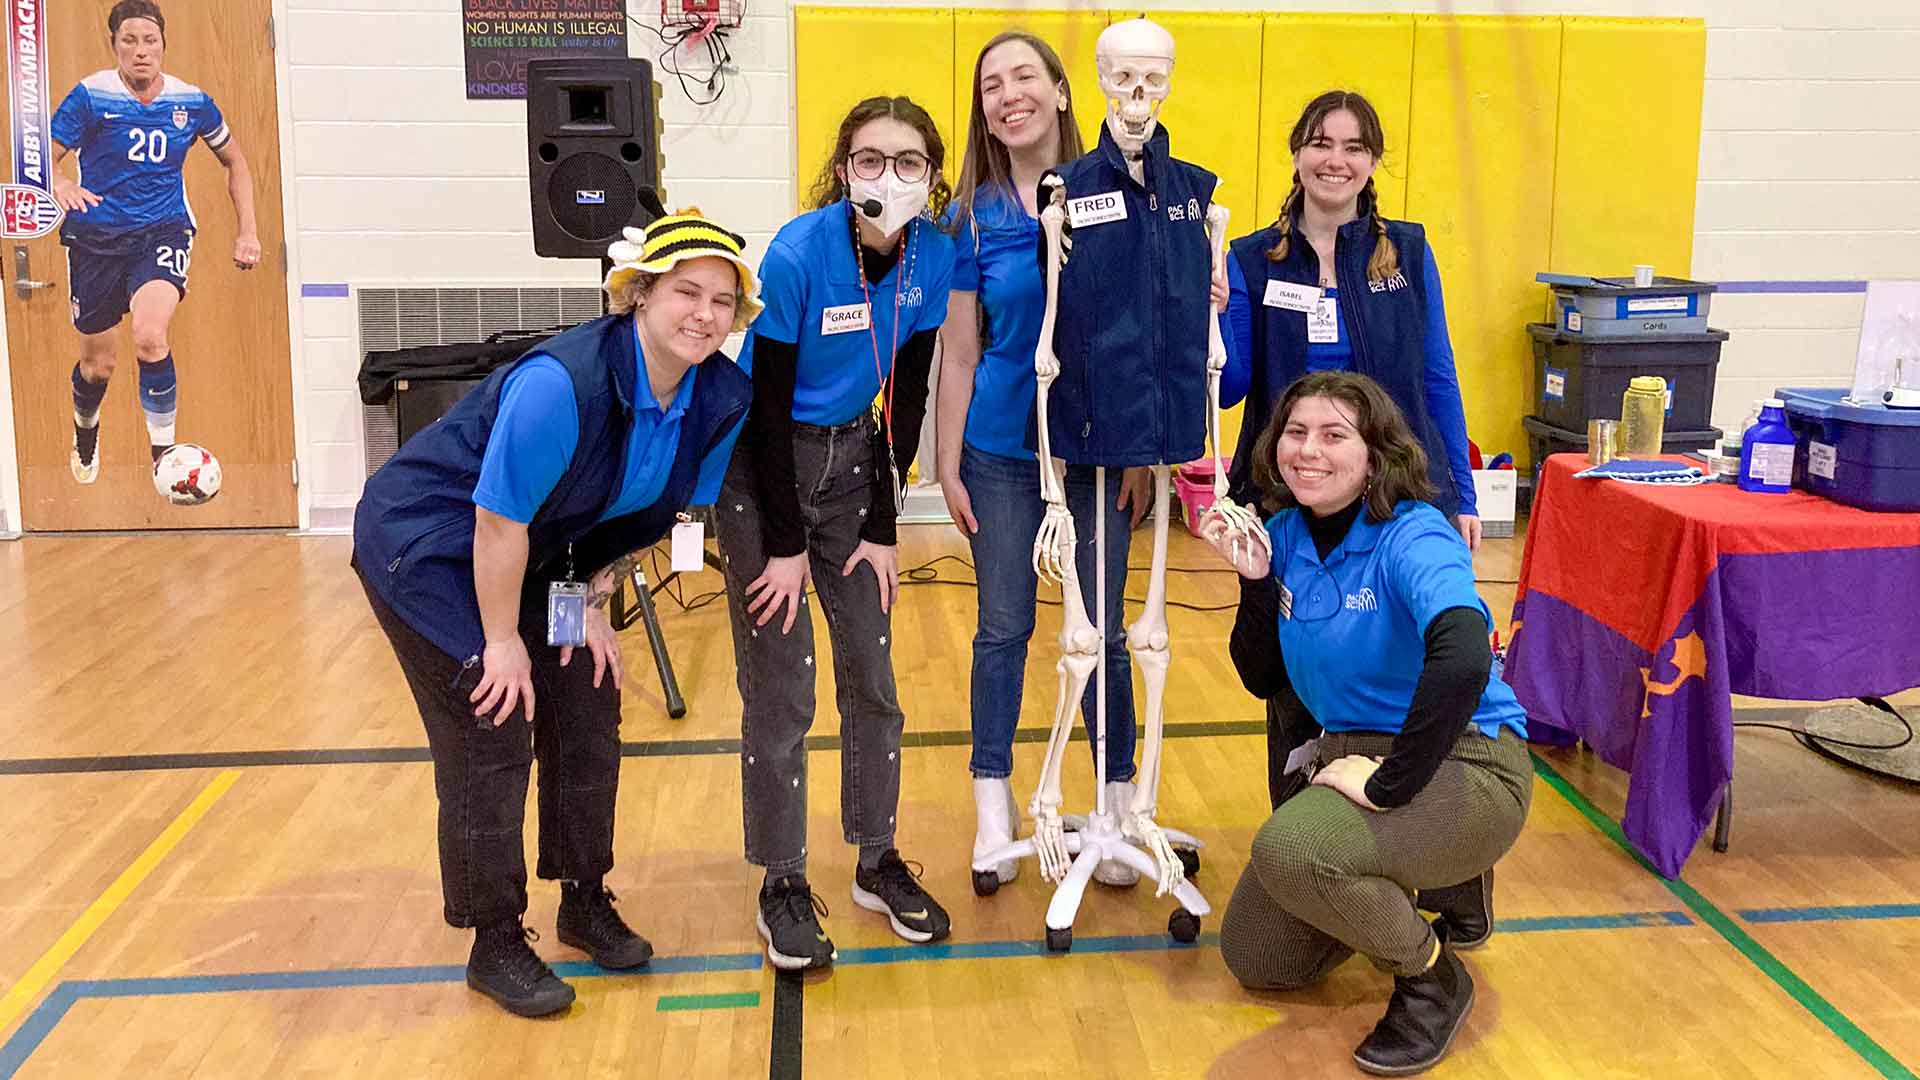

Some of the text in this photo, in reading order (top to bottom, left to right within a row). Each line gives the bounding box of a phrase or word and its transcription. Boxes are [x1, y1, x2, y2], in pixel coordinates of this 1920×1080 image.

[469, 0, 619, 9] BLACK LIVES MATTER
[465, 11, 624, 20] WOMEN'S RIGHTS ARE HUMAN RIGHTS
[466, 21, 624, 35] NO HUMAN IS ILLEGAL
[471, 36, 514, 48] SCIENCE
[518, 36, 528, 48] IS
[531, 36, 557, 48] REAL
[475, 60, 528, 81] LOVE
[18, 0, 42, 184] ABBY WAMBACH
[468, 82, 528, 96] KINDNES
[128, 127, 168, 163] 20
[1074, 196, 1116, 214] FRED
[1167, 205, 1184, 214] PAC
[1169, 210, 1185, 221] SCI
[156, 246, 189, 277] 20
[831, 309, 864, 322] GRACE
